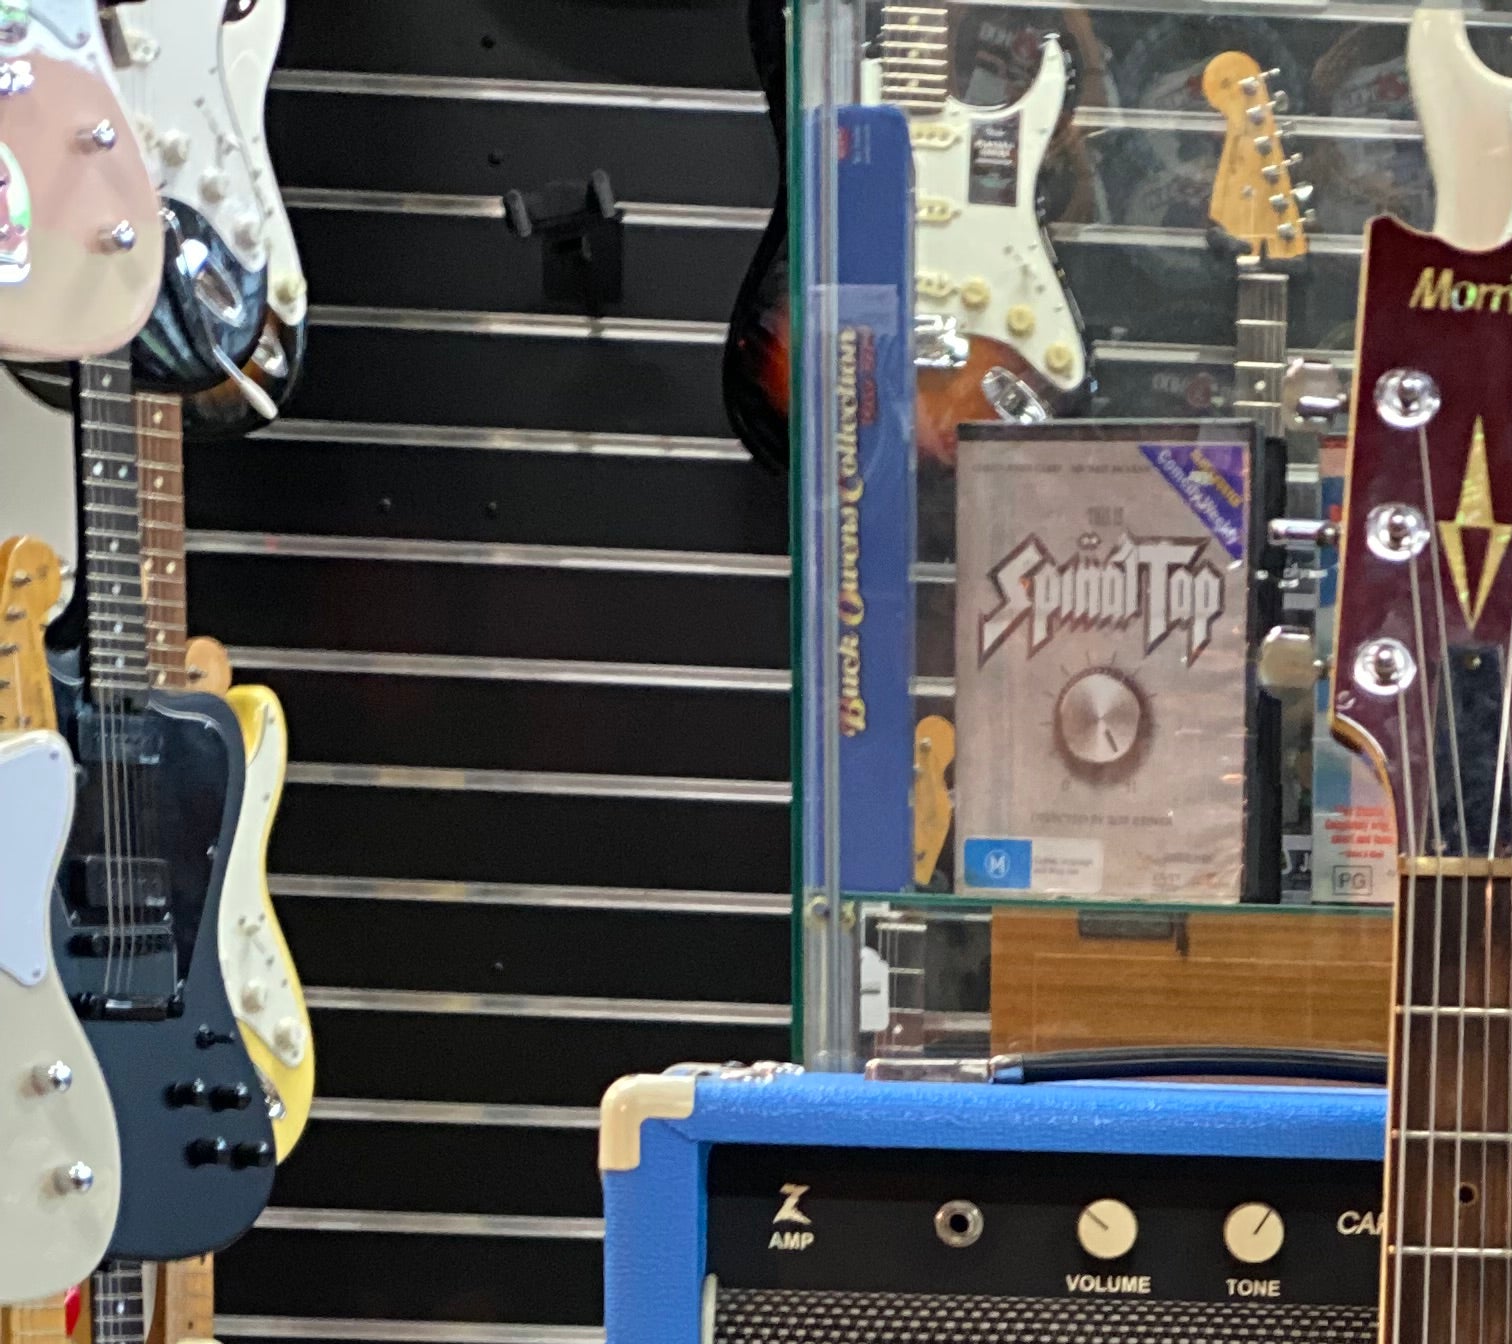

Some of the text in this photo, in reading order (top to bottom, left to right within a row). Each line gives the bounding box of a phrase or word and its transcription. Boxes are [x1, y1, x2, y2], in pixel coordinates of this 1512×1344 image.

[1124, 535, 1226, 668] Tap
[1337, 871, 1367, 890] PG
[768, 1231, 814, 1250] AMP
[1065, 1274, 1151, 1295] VOLUME
[1226, 1278, 1281, 1298] TONE
